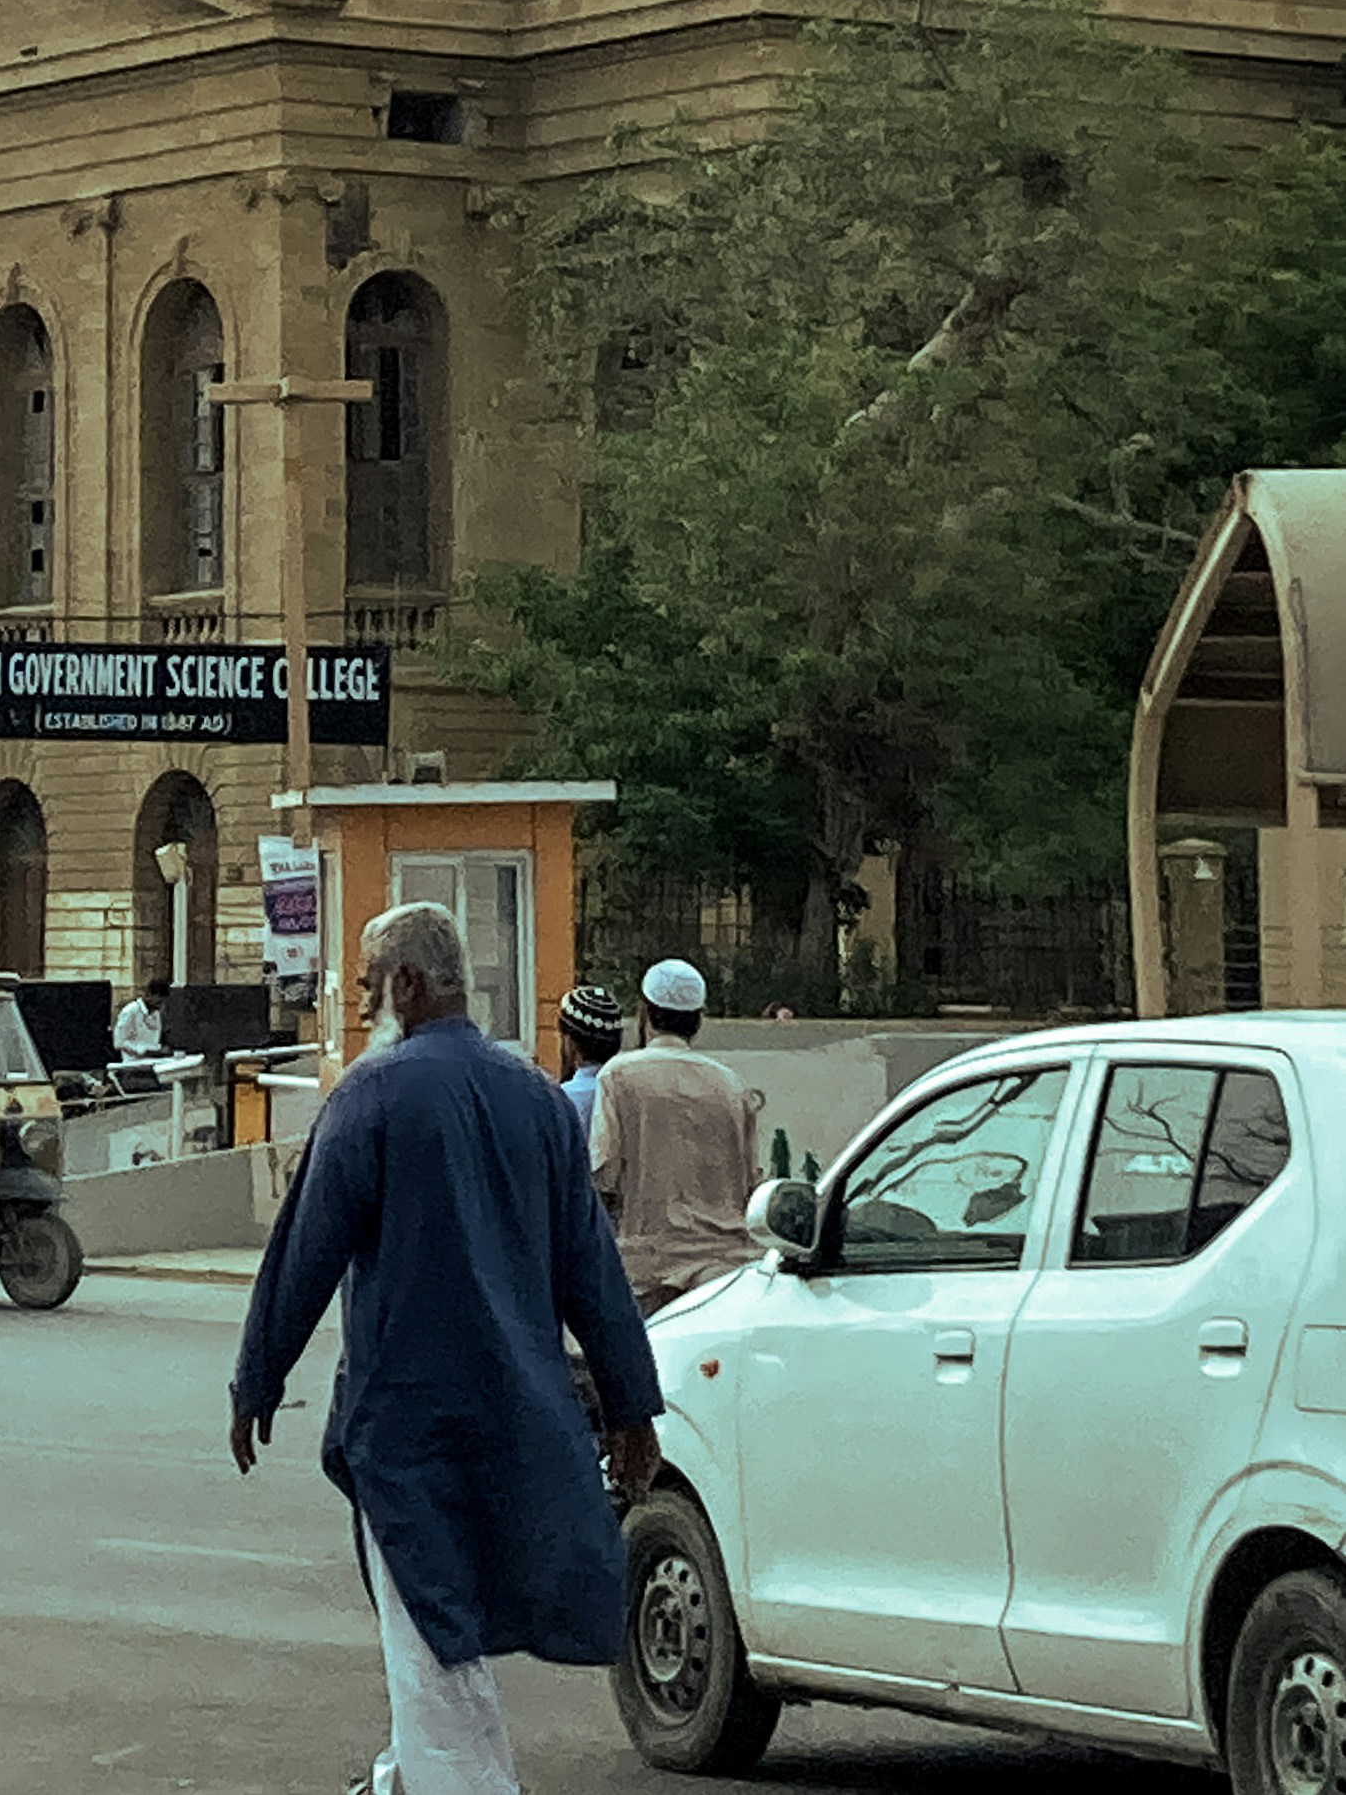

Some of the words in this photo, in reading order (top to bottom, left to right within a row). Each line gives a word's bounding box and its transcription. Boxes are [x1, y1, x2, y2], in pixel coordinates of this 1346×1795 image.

[8, 652, 158, 697] GOVERNMENT
[165, 655, 265, 698] SCIENCE
[272, 656, 380, 701] CLLEGE
